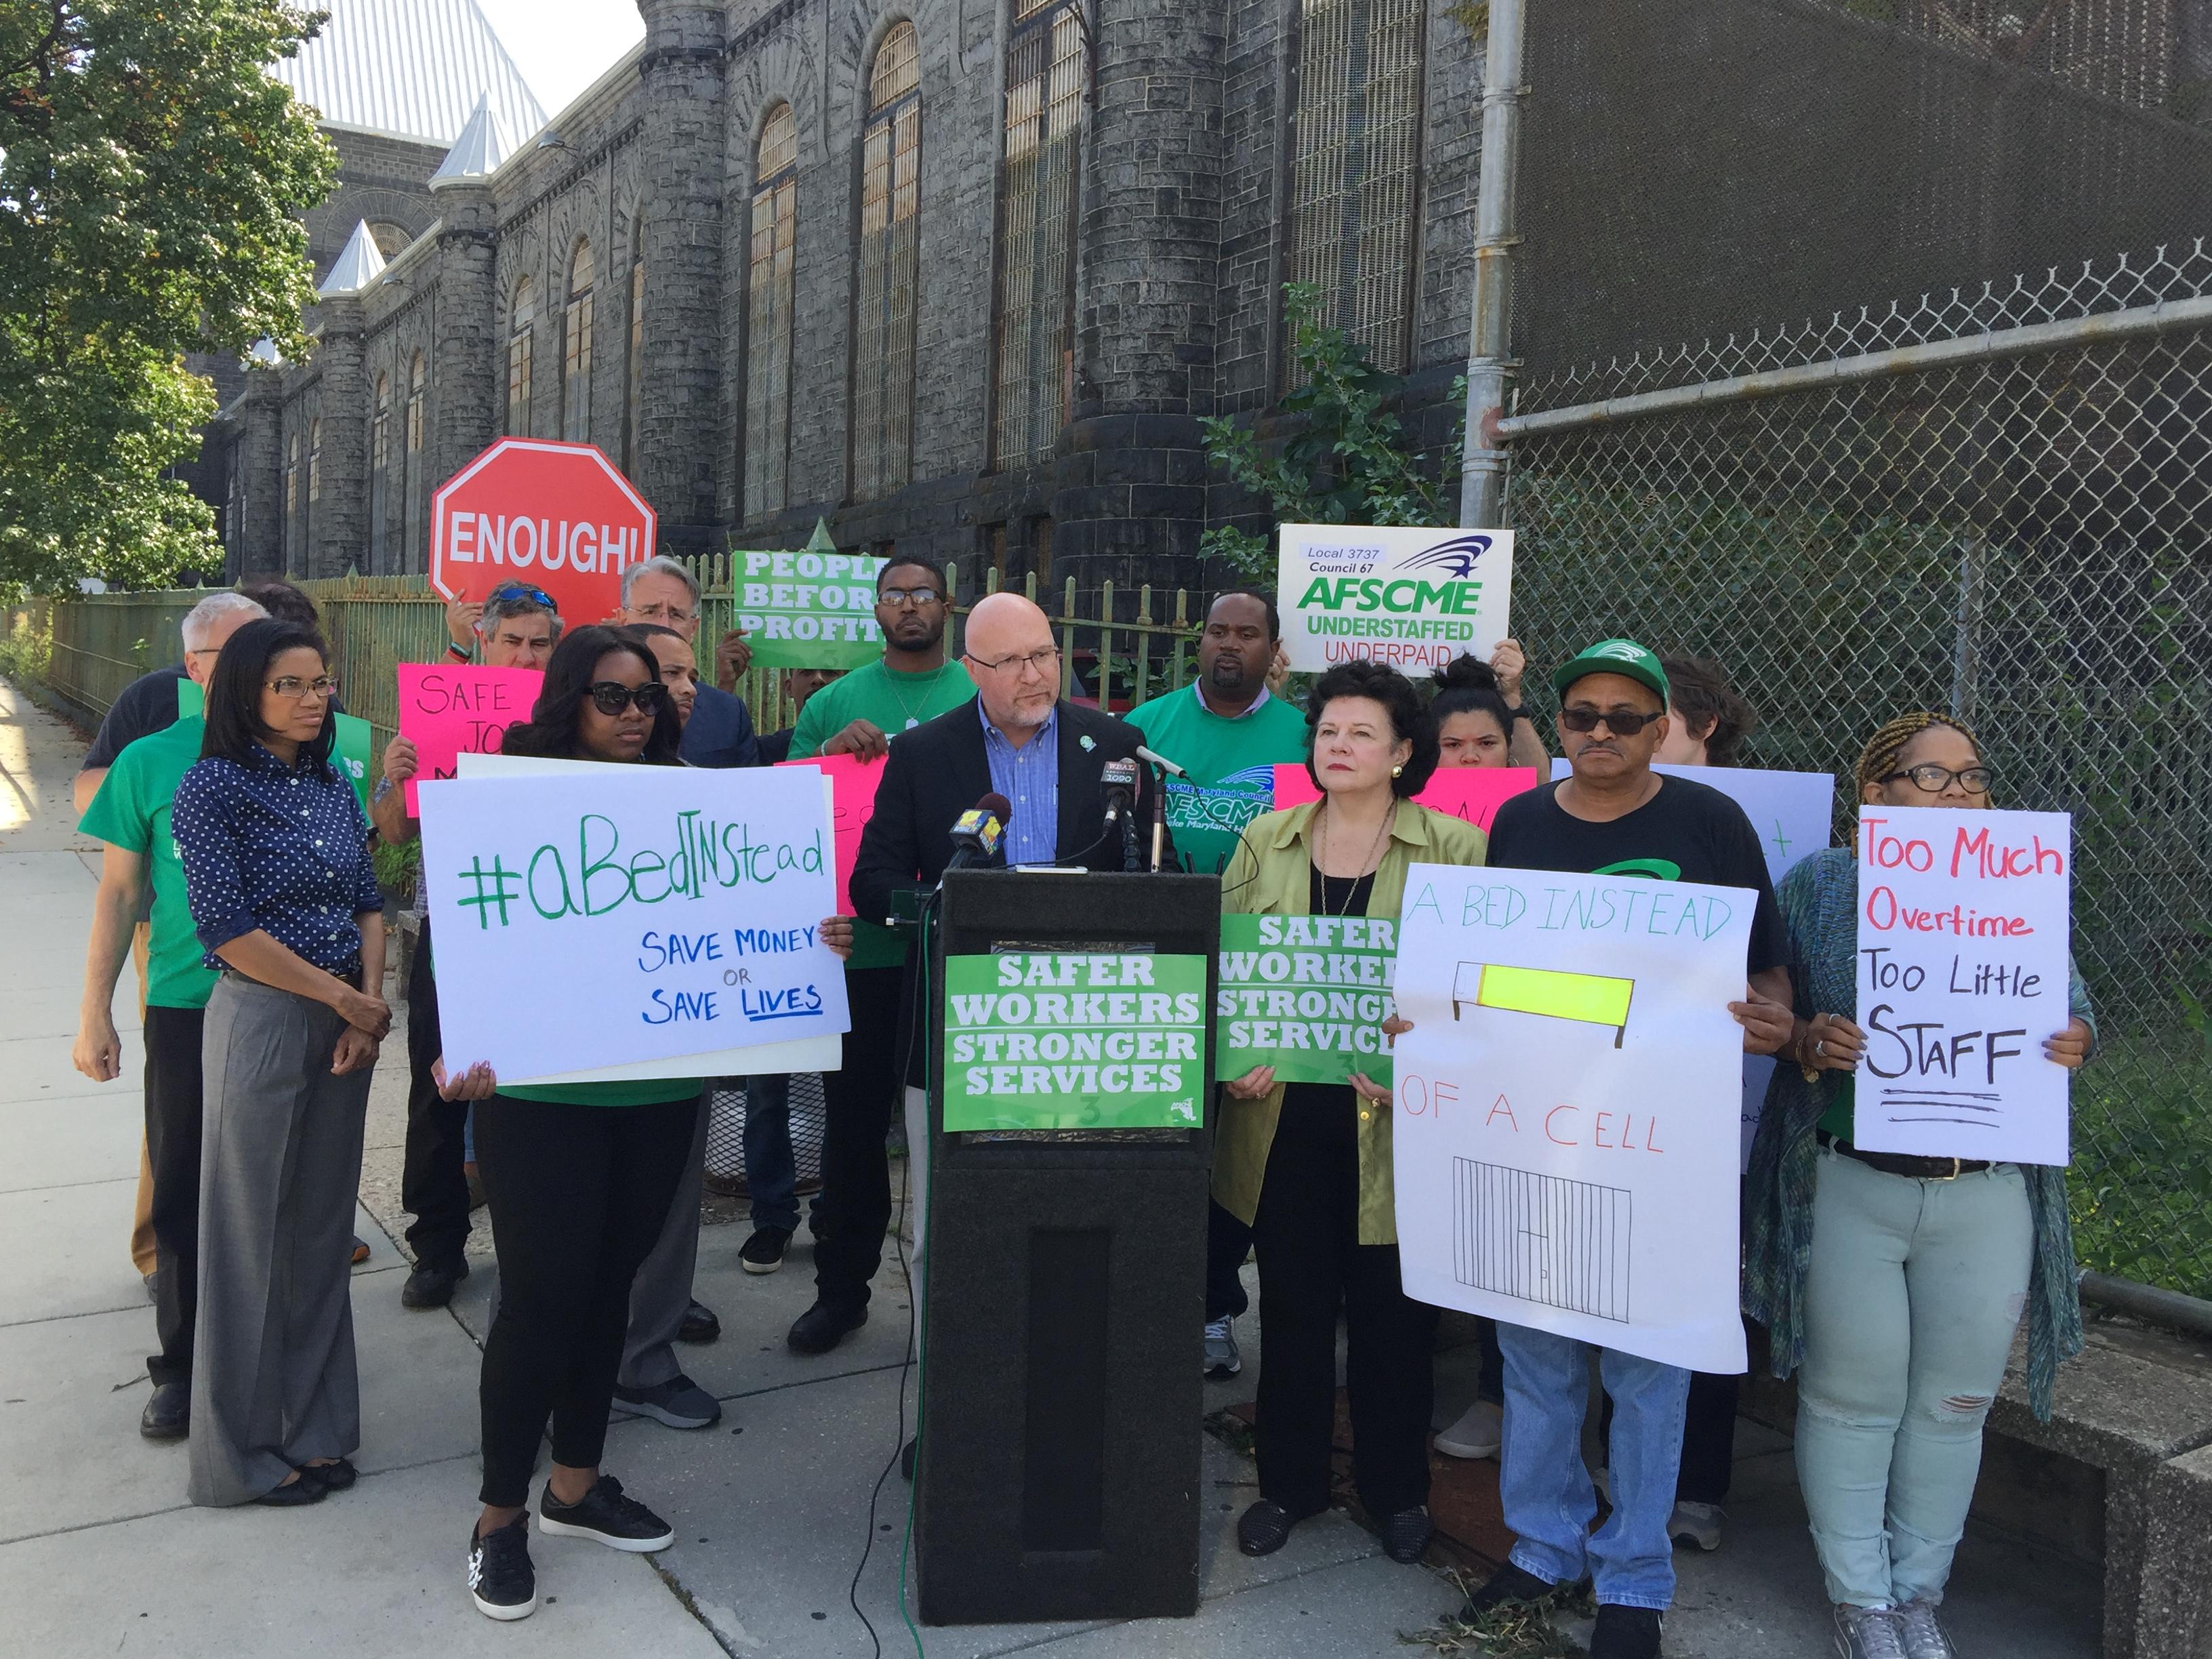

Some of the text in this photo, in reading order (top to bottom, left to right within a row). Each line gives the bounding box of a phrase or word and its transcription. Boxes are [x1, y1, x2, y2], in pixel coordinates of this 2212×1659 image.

[450, 511, 638, 575] ENOUGH!
[1308, 548, 1380, 560] Local 3737
[1309, 562, 1374, 574] Council 67
[743, 583, 878, 610] BEFOR
[1296, 577, 1483, 615] AFSCME
[739, 615, 886, 642] PROFIT
[1307, 615, 1474, 641] UNDERSTAFFED
[1325, 640, 1452, 667] UNDERPAID
[416, 675, 512, 714] SAFE
[464, 720, 526, 754] JO
[1165, 783, 1195, 795] FSCME
[1237, 790, 1271, 803] Council
[1950, 827, 2064, 879] Much
[1406, 883, 1732, 941] A BED INSTEAD
[1866, 886, 2034, 937] Overtime
[639, 926, 815, 972] SAVE MONEY
[1258, 916, 1395, 950] SAFER
[723, 968, 752, 986] OR
[998, 955, 1155, 987] SAFER
[1950, 955, 2042, 998] Little
[642, 984, 823, 1025] SAVE LIVES
[951, 993, 1200, 1026] WORKERS
[954, 1031, 1197, 1063] STRONGER
[1866, 1004, 2026, 1085] STAFF
[966, 1064, 1183, 1095] SERVICES
[1401, 1075, 1664, 1153] OF A CELL
